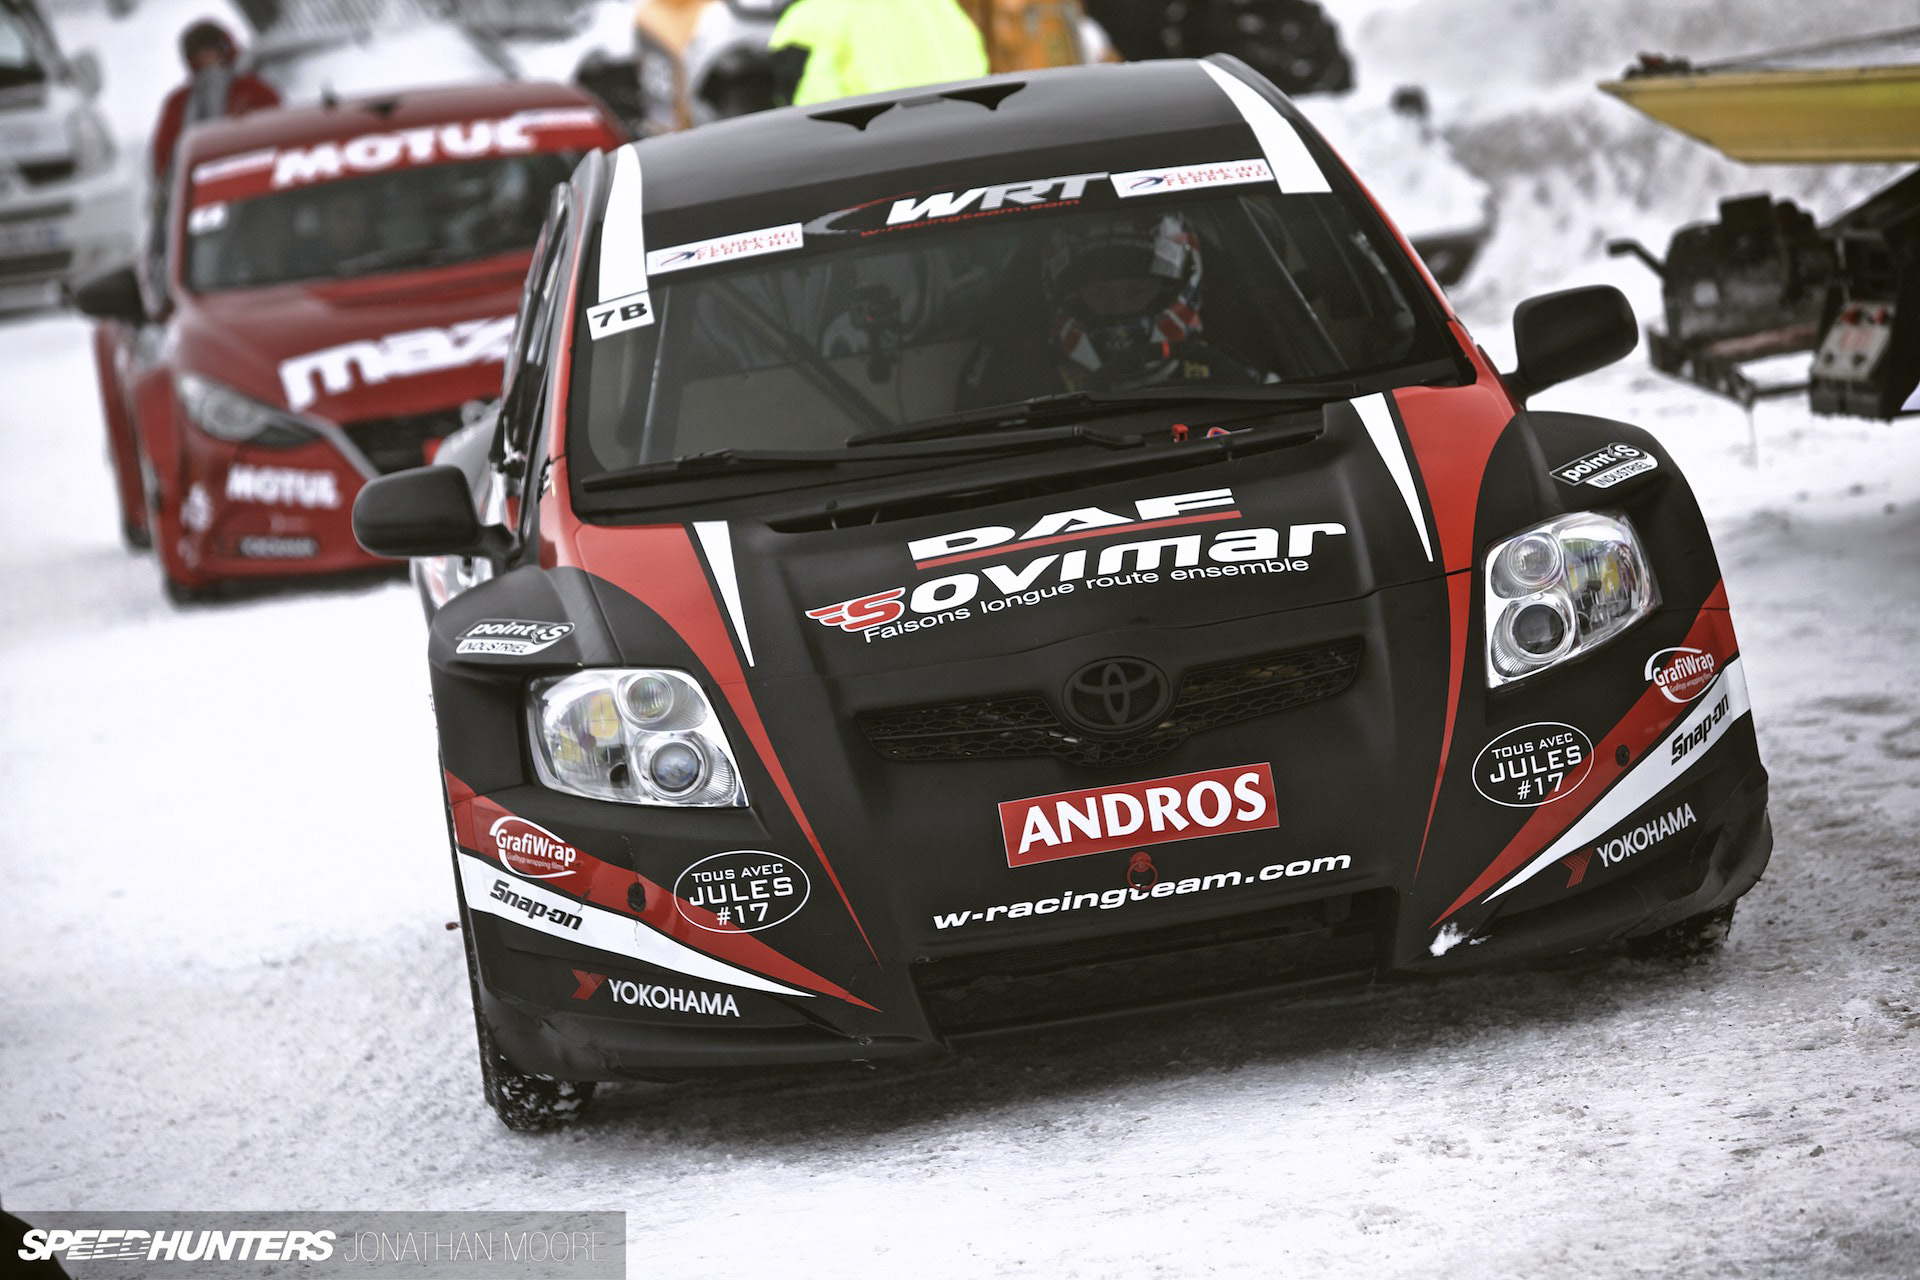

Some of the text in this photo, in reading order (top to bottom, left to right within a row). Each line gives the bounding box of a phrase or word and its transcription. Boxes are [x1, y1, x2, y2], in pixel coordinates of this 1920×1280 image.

[271, 117, 537, 190] MOTUL
[886, 171, 1109, 226] WRT
[592, 302, 648, 328] 7B
[1562, 453, 1616, 481] point
[907, 488, 1237, 561] DAF
[863, 556, 1310, 644] Faisons longue route ensemble
[466, 621, 538, 637] point
[1653, 652, 1715, 687] GrafiWrap
[1492, 732, 1574, 760] TOUS AVEC
[1671, 693, 1729, 766] Snap-on
[1490, 745, 1582, 783] JULES
[1517, 772, 1564, 800] #17
[1018, 772, 1267, 855] ANDROS
[496, 828, 577, 867] GrafiWrap
[1596, 802, 1697, 868] YOKOHAMA
[689, 876, 794, 906] JULES
[691, 863, 784, 883] TOUS AVEC
[933, 853, 1352, 930] w-racingteam.com
[490, 879, 583, 931] Snap-on
[716, 902, 769, 926] #17
[607, 978, 740, 1017] YOKOHAMA
